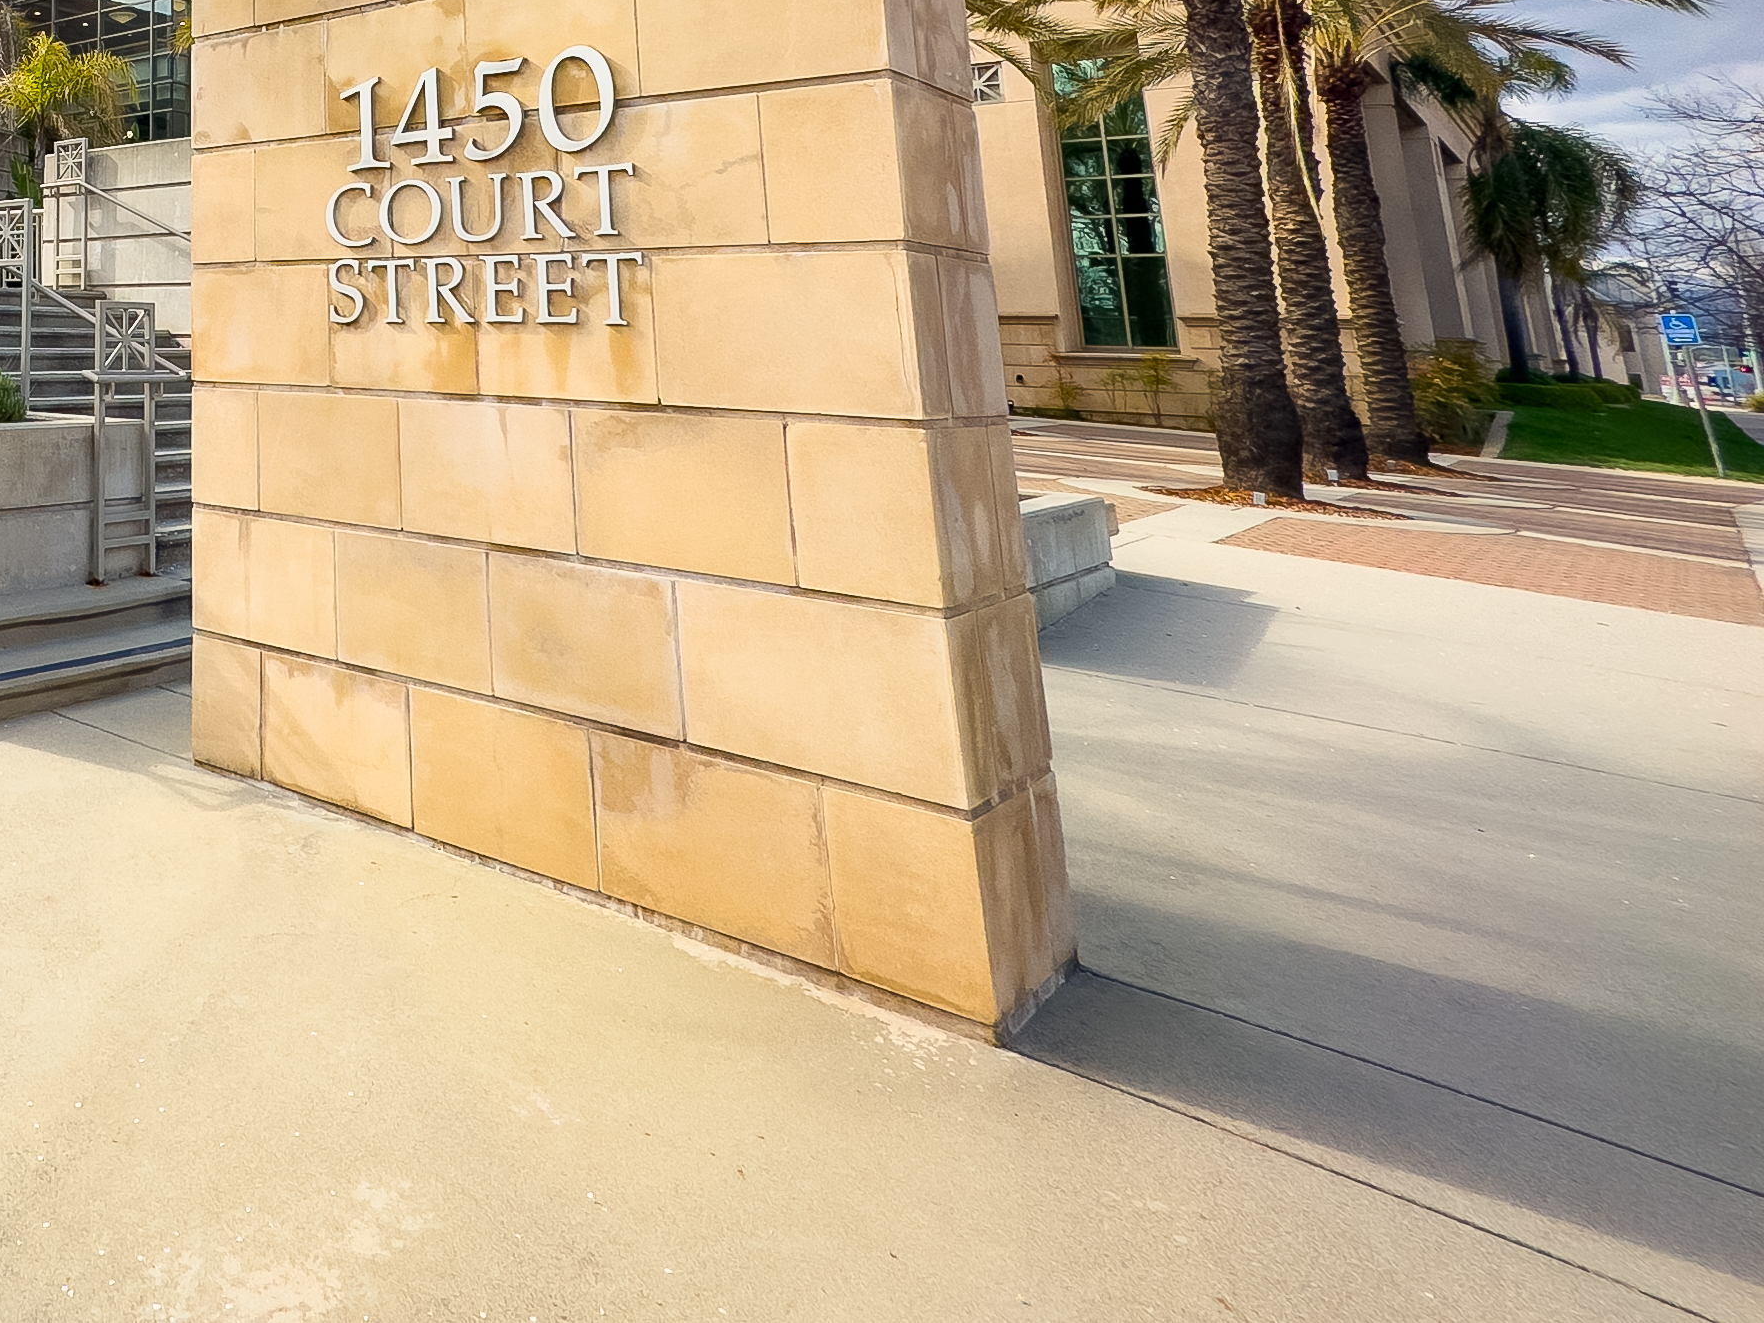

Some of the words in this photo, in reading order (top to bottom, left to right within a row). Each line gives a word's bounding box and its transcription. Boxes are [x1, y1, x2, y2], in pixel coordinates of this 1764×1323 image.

[340, 44, 616, 172] 1450
[325, 162, 634, 248] COURT
[329, 251, 643, 326] STREET
